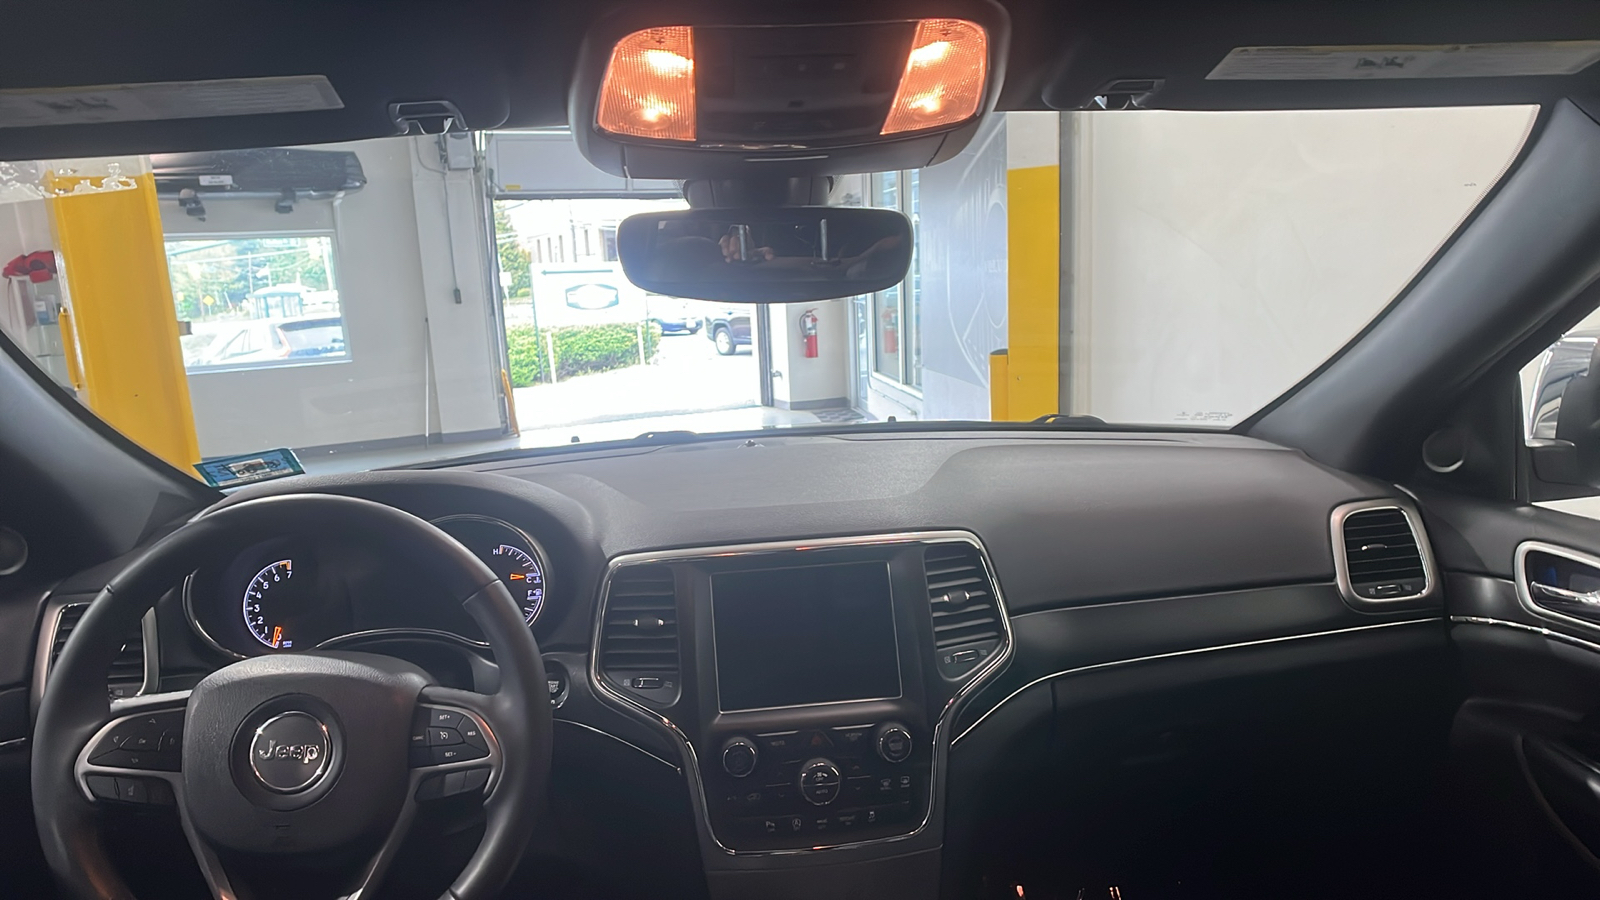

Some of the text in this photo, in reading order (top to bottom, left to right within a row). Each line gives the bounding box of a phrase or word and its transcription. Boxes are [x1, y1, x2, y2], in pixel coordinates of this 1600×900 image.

[274, 574, 280, 582] 6
[287, 571, 292, 579] 7
[256, 591, 262, 599] 4
[254, 604, 260, 612] 3
[257, 616, 264, 625] 2
[258, 740, 320, 764] Jeep
